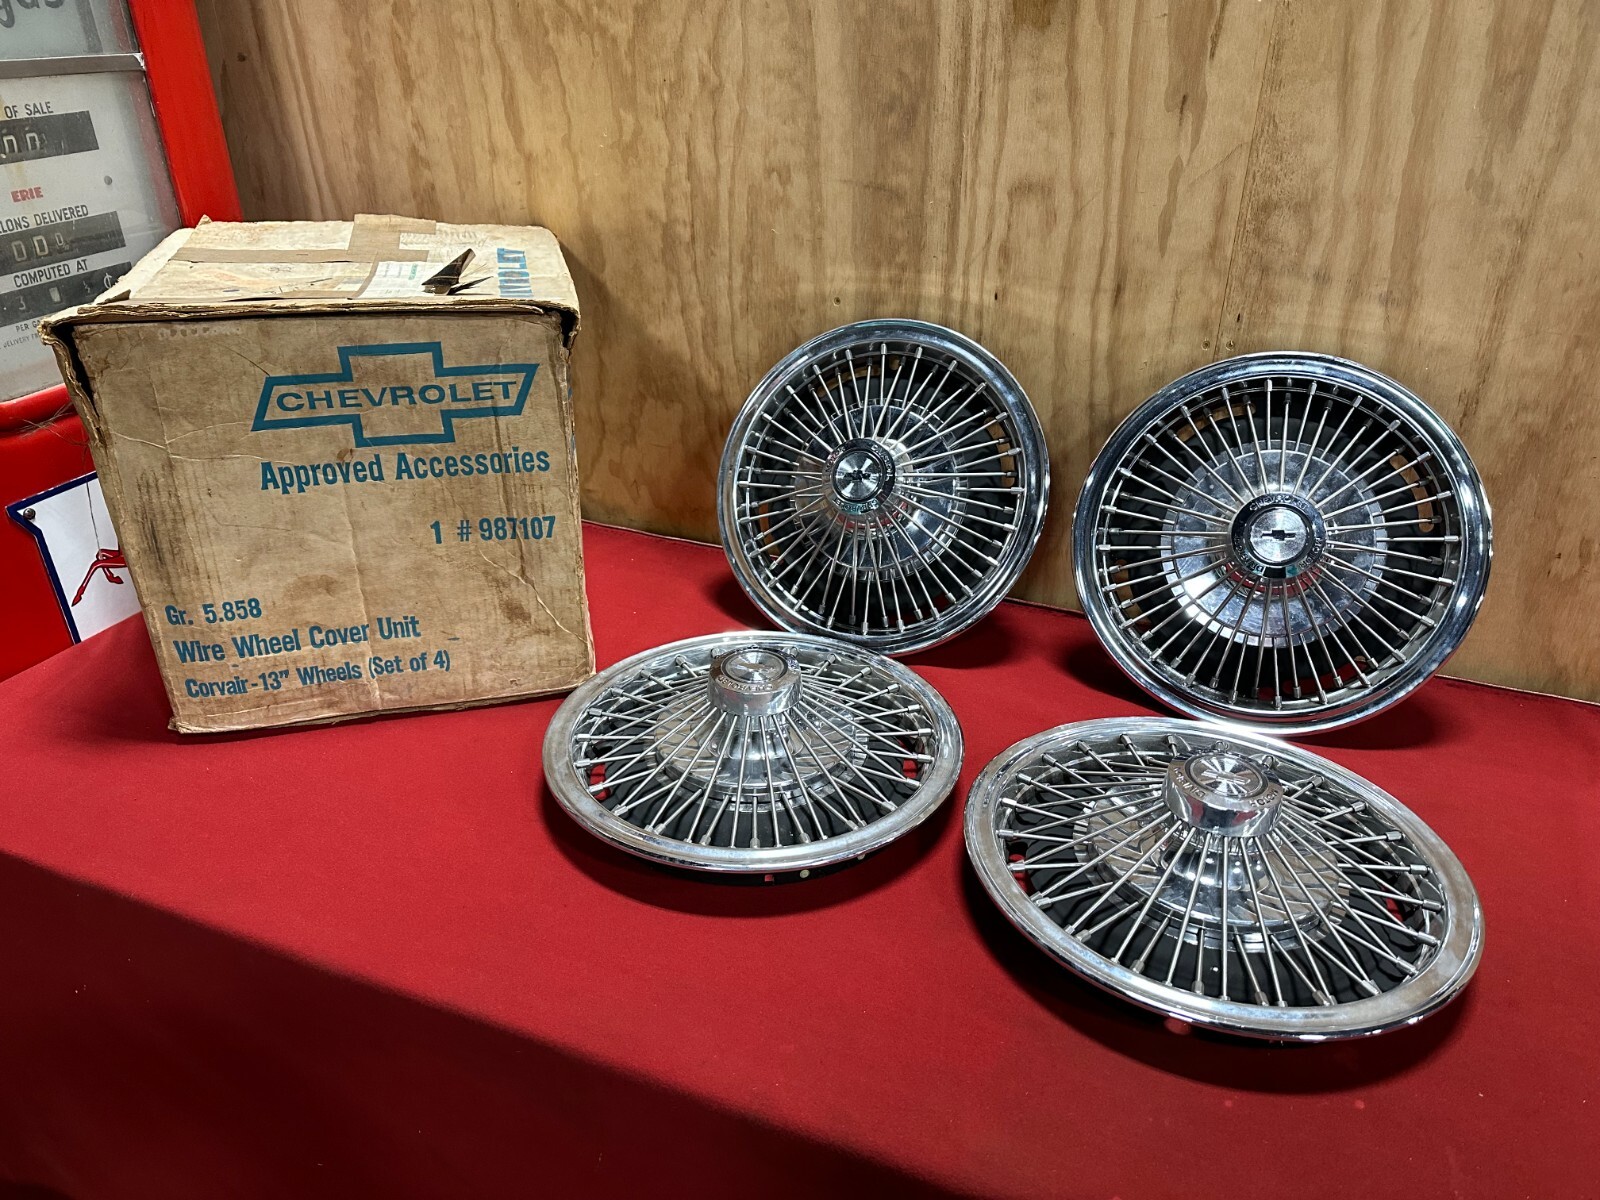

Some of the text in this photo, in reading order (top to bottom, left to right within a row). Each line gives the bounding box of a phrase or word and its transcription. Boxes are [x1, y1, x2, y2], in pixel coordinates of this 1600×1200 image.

[4, 101, 54, 118] OF SALE
[11, 187, 43, 202] ERIE
[0, 204, 88, 234] LONS DELIVERED
[13, 263, 70, 288] COMPUTED
[76, 259, 88, 272] AT
[16, 323, 29, 332] PER
[276, 381, 517, 412] CHEVROLET
[260, 446, 551, 494] Approved Accessories
[430, 515, 556, 544] 1 # 987107
[164, 598, 262, 626] Gr. 5.858
[173, 615, 421, 664] Wire Wheel Cover Unit
[296, 661, 363, 686] Wheels
[368, 654, 405, 679] (Set
[409, 652, 428, 672] of
[433, 649, 451, 672] 4)
